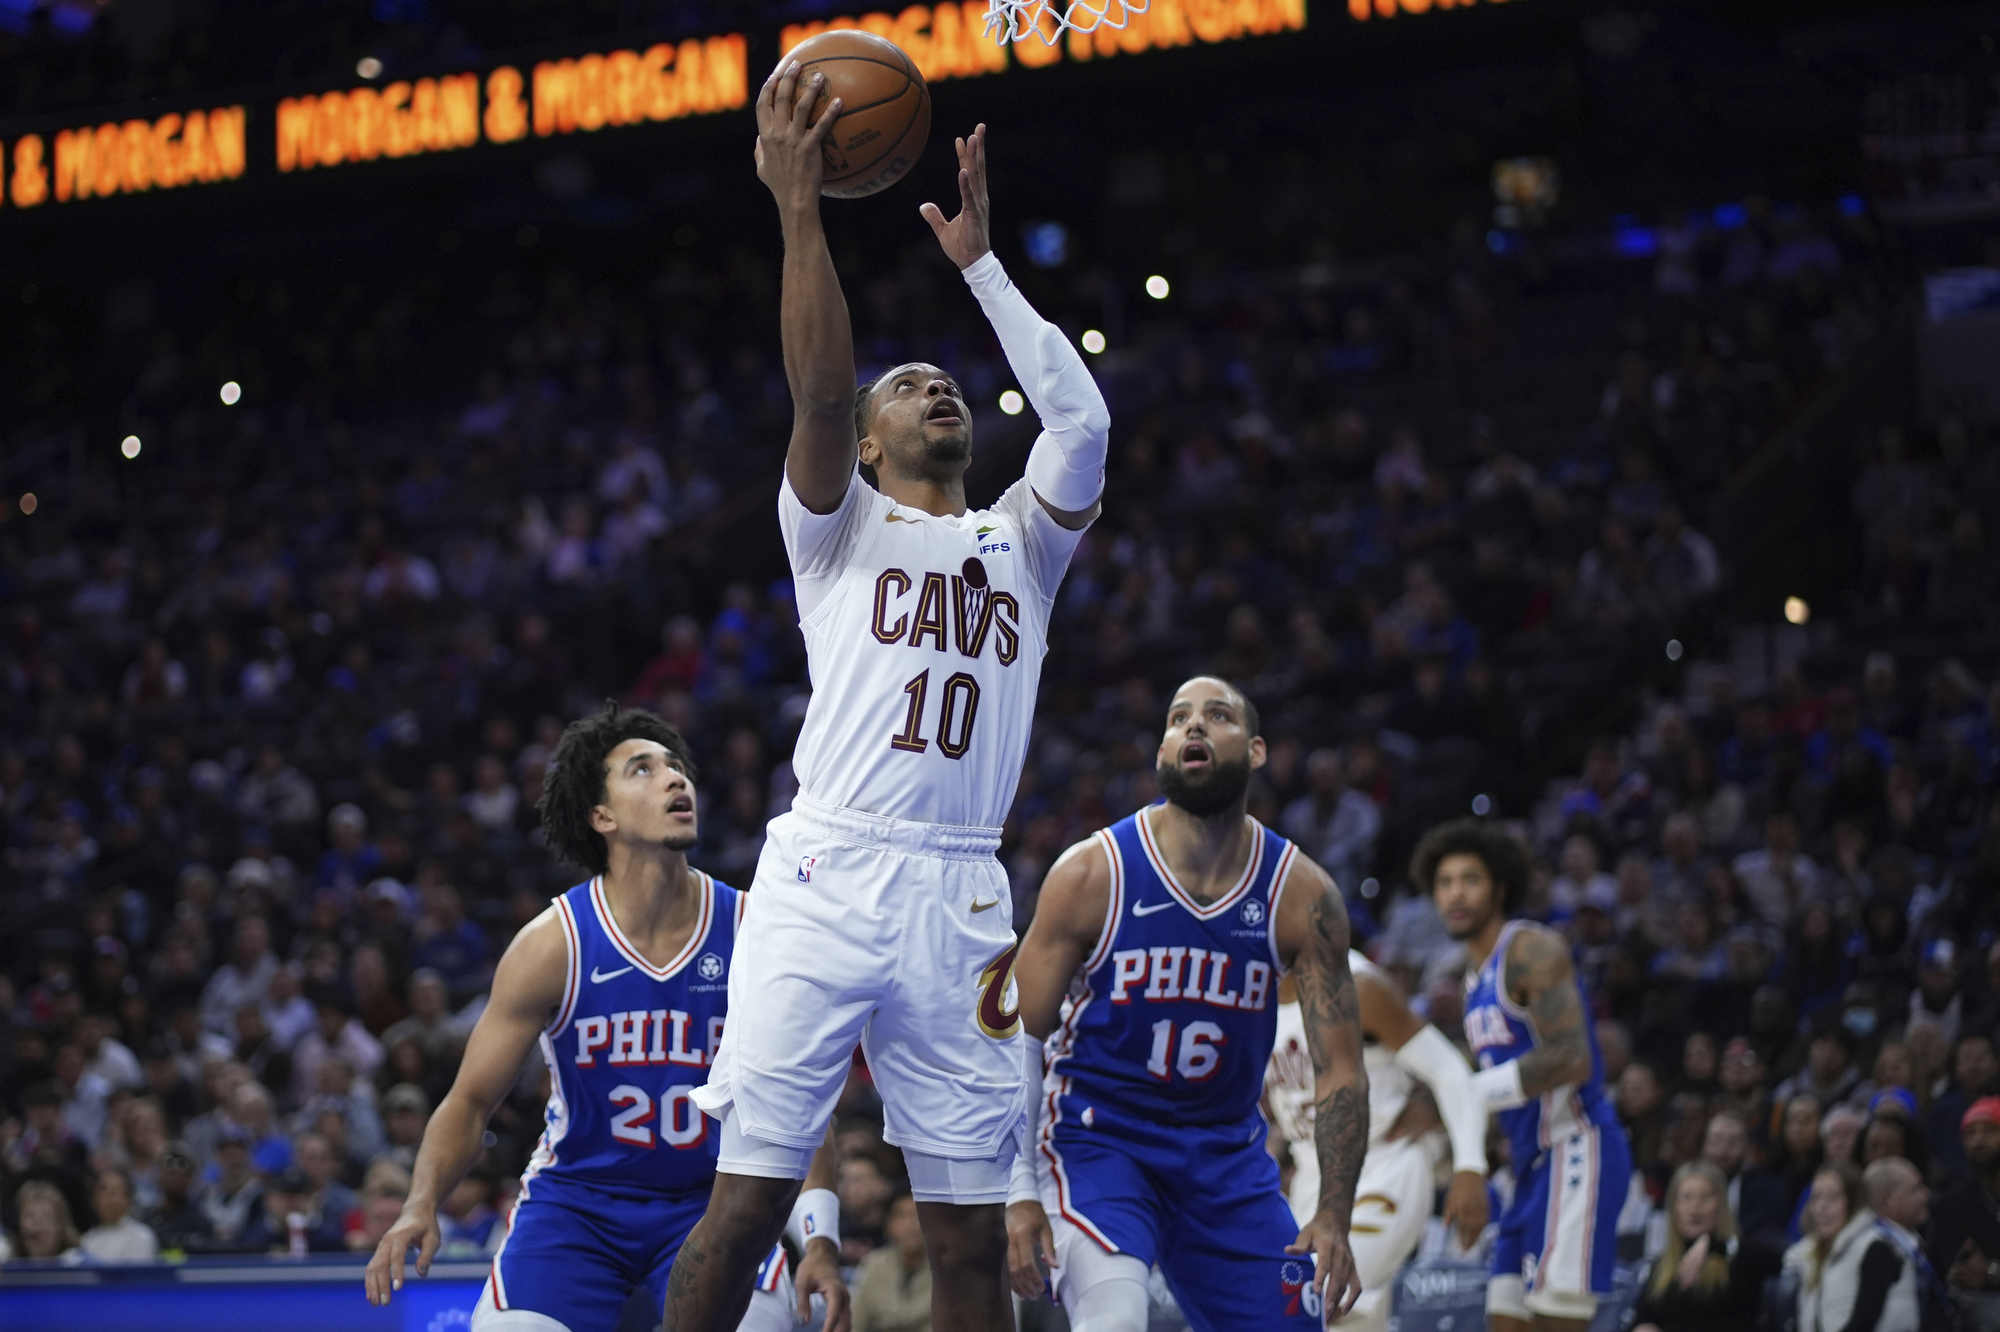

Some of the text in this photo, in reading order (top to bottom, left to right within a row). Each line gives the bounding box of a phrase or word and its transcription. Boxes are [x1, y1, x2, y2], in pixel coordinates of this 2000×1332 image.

[277, 33, 748, 172] MORGAN & MORGAN
[12, 133, 48, 208] &
[54, 106, 246, 202] MORGAN
[871, 562, 1019, 667] CAVS
[891, 667, 980, 760] 10
[1110, 946, 1273, 1011] PHILA
[1147, 1018, 1228, 1082] 16
[608, 1084, 708, 1150] 20
